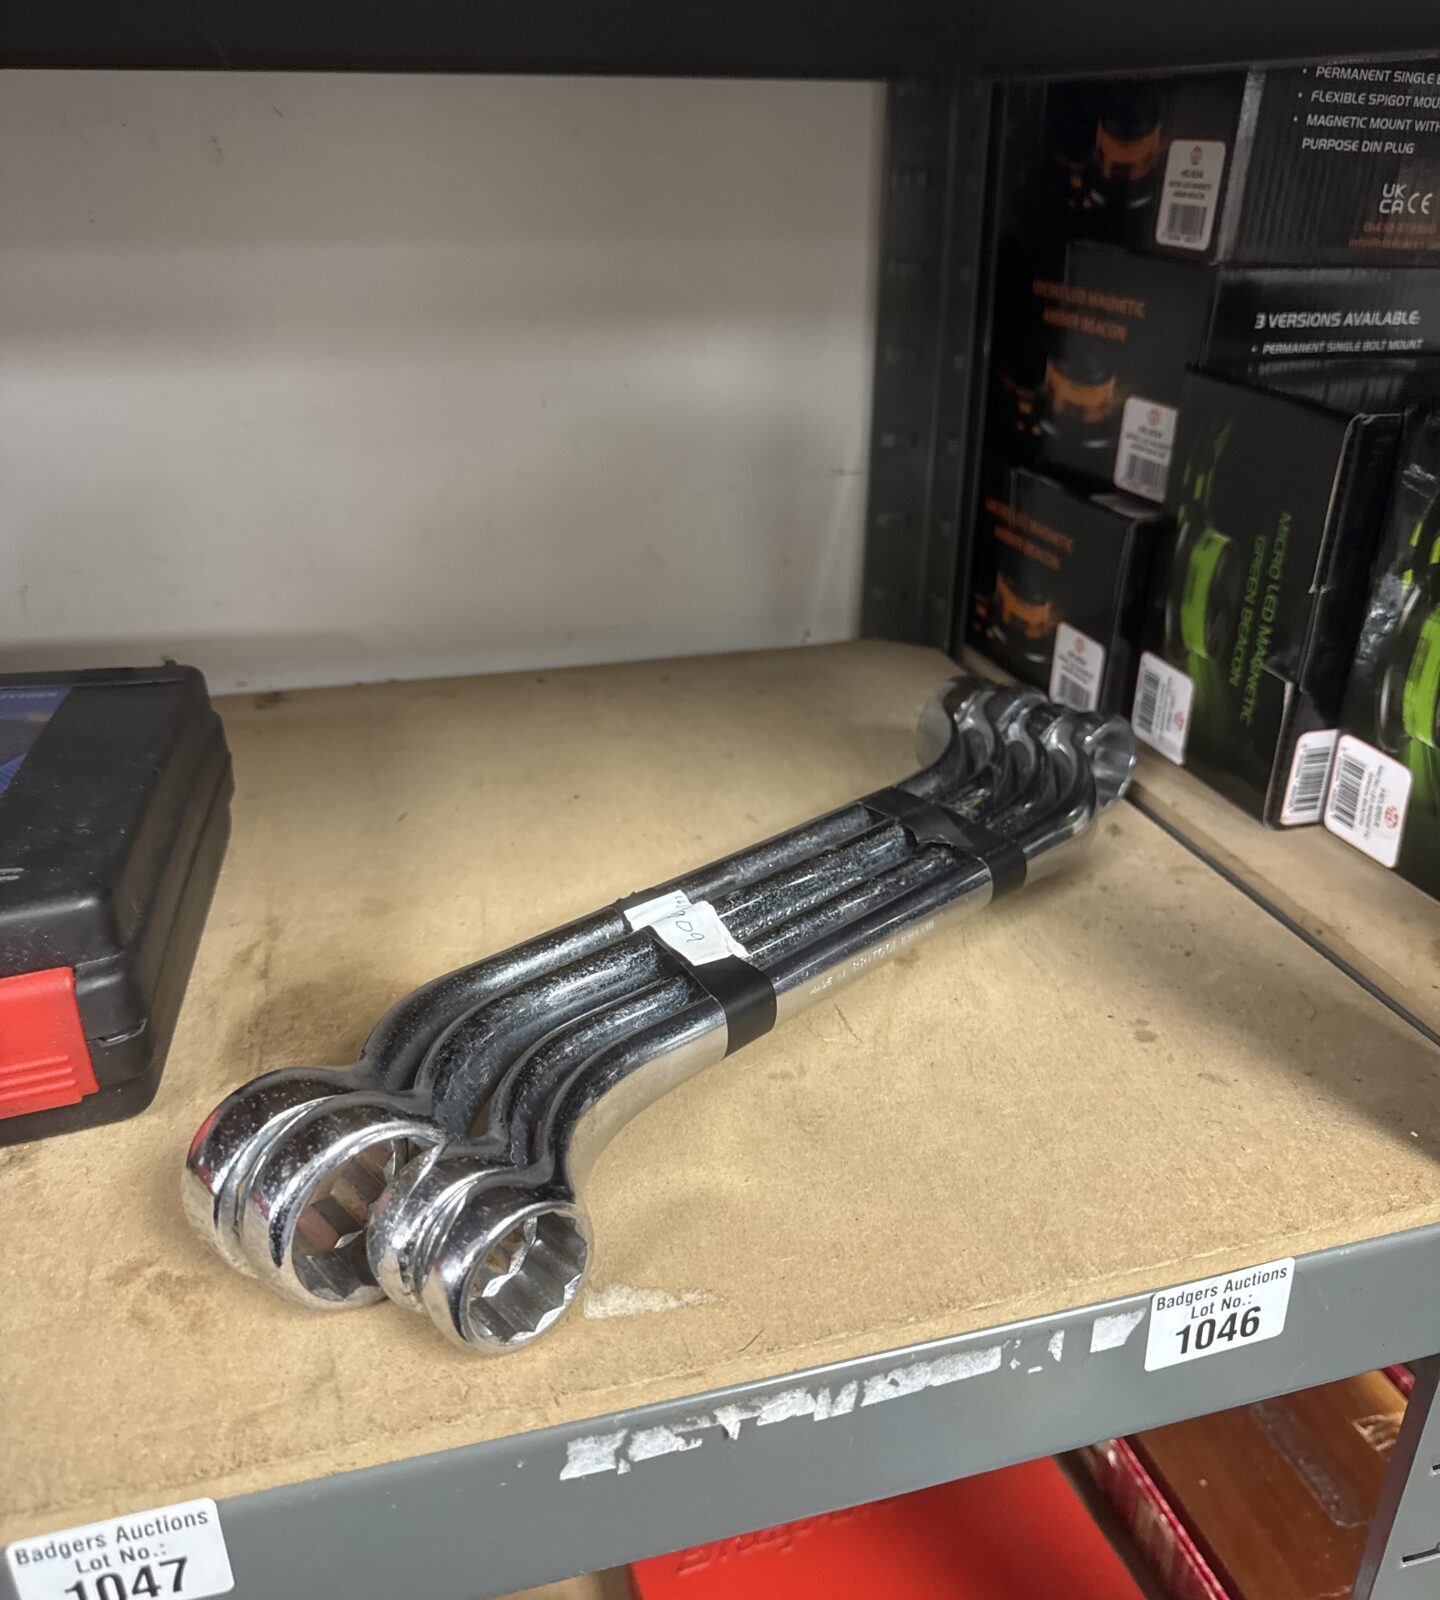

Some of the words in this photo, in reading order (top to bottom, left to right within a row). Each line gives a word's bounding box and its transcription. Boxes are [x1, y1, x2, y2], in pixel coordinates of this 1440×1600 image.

[1315, 66, 1392, 82] PERMANENT
[1393, 70, 1435, 85] SINGLE
[1311, 90, 1366, 105] FLEXIBLE
[1367, 93, 1412, 107] SPIGOT
[1413, 96, 1440, 109] MOU
[1306, 113, 1367, 129] MAGNETIC
[1369, 117, 1412, 131] MOUNT
[1301, 137, 1360, 151] PURPOSE
[1361, 140, 1382, 153] DIN
[1384, 142, 1415, 154] PLUG
[1382, 183, 1407, 198] UK
[1379, 199, 1404, 214] CA
[1254, 312, 1268, 329] 3
[1268, 312, 1341, 328] VERSIONS
[1262, 340, 1326, 355] PERMANENT
[1326, 340, 1362, 353] SINGLE
[1362, 340, 1387, 352] BOLT
[1387, 338, 1424, 351] MOUNT
[1261, 584, 1280, 622] LED
[1228, 607, 1252, 687] BEACON
[1156, 1285, 1218, 1311] Badgers
[1223, 1267, 1287, 1294] Auctions
[1191, 1302, 1215, 1320] Lot
[1176, 1306, 1261, 1355] 1046
[14, 1532, 107, 1566] Badgers
[115, 1510, 209, 1544] Auctions
[75, 1553, 111, 1574] Lot
[64, 1556, 188, 1600] 1047
